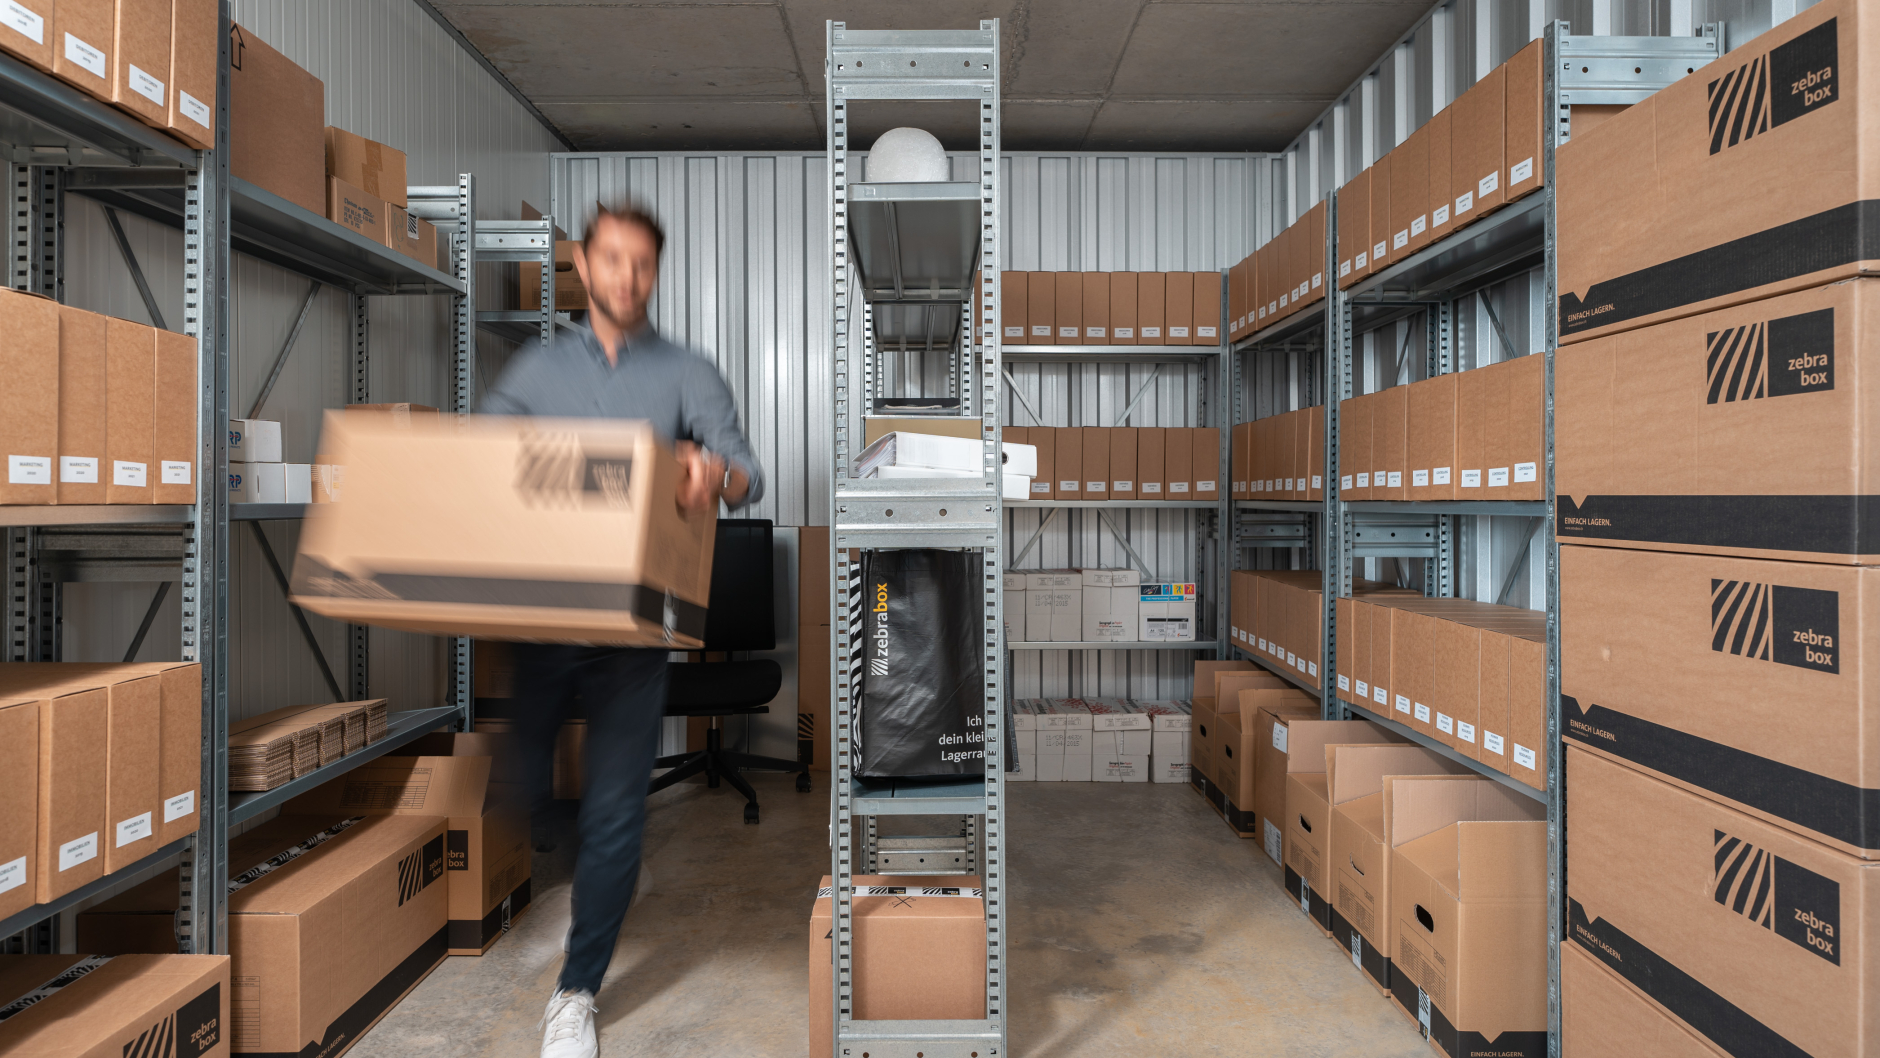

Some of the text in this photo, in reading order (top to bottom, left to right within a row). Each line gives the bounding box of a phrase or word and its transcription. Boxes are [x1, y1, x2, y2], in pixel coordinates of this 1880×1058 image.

[1791, 66, 1832, 95] zebra
[1804, 84, 1832, 106] box
[1568, 303, 1615, 322] EINFACH LAGERN.
[1788, 352, 1828, 370] zebra
[1801, 370, 1827, 386] box
[873, 582, 888, 656] zebrabox
[1793, 629, 1833, 648] zebra
[1805, 646, 1832, 666] box
[967, 715, 982, 726] Ich
[939, 731, 984, 745] dein klei
[1570, 719, 1617, 742] EINFACH LAGERN.
[429, 856, 442, 871] zebra
[447, 851, 464, 859] ebra
[448, 859, 464, 867] box
[432, 866, 442, 878] box
[1794, 907, 1834, 938] zebra
[1577, 924, 1598, 945] EINFACH
[1599, 940, 1622, 962] LAGERN.
[1806, 928, 1833, 955] box
[190, 1017, 216, 1043] zebra
[199, 1031, 216, 1050] box
